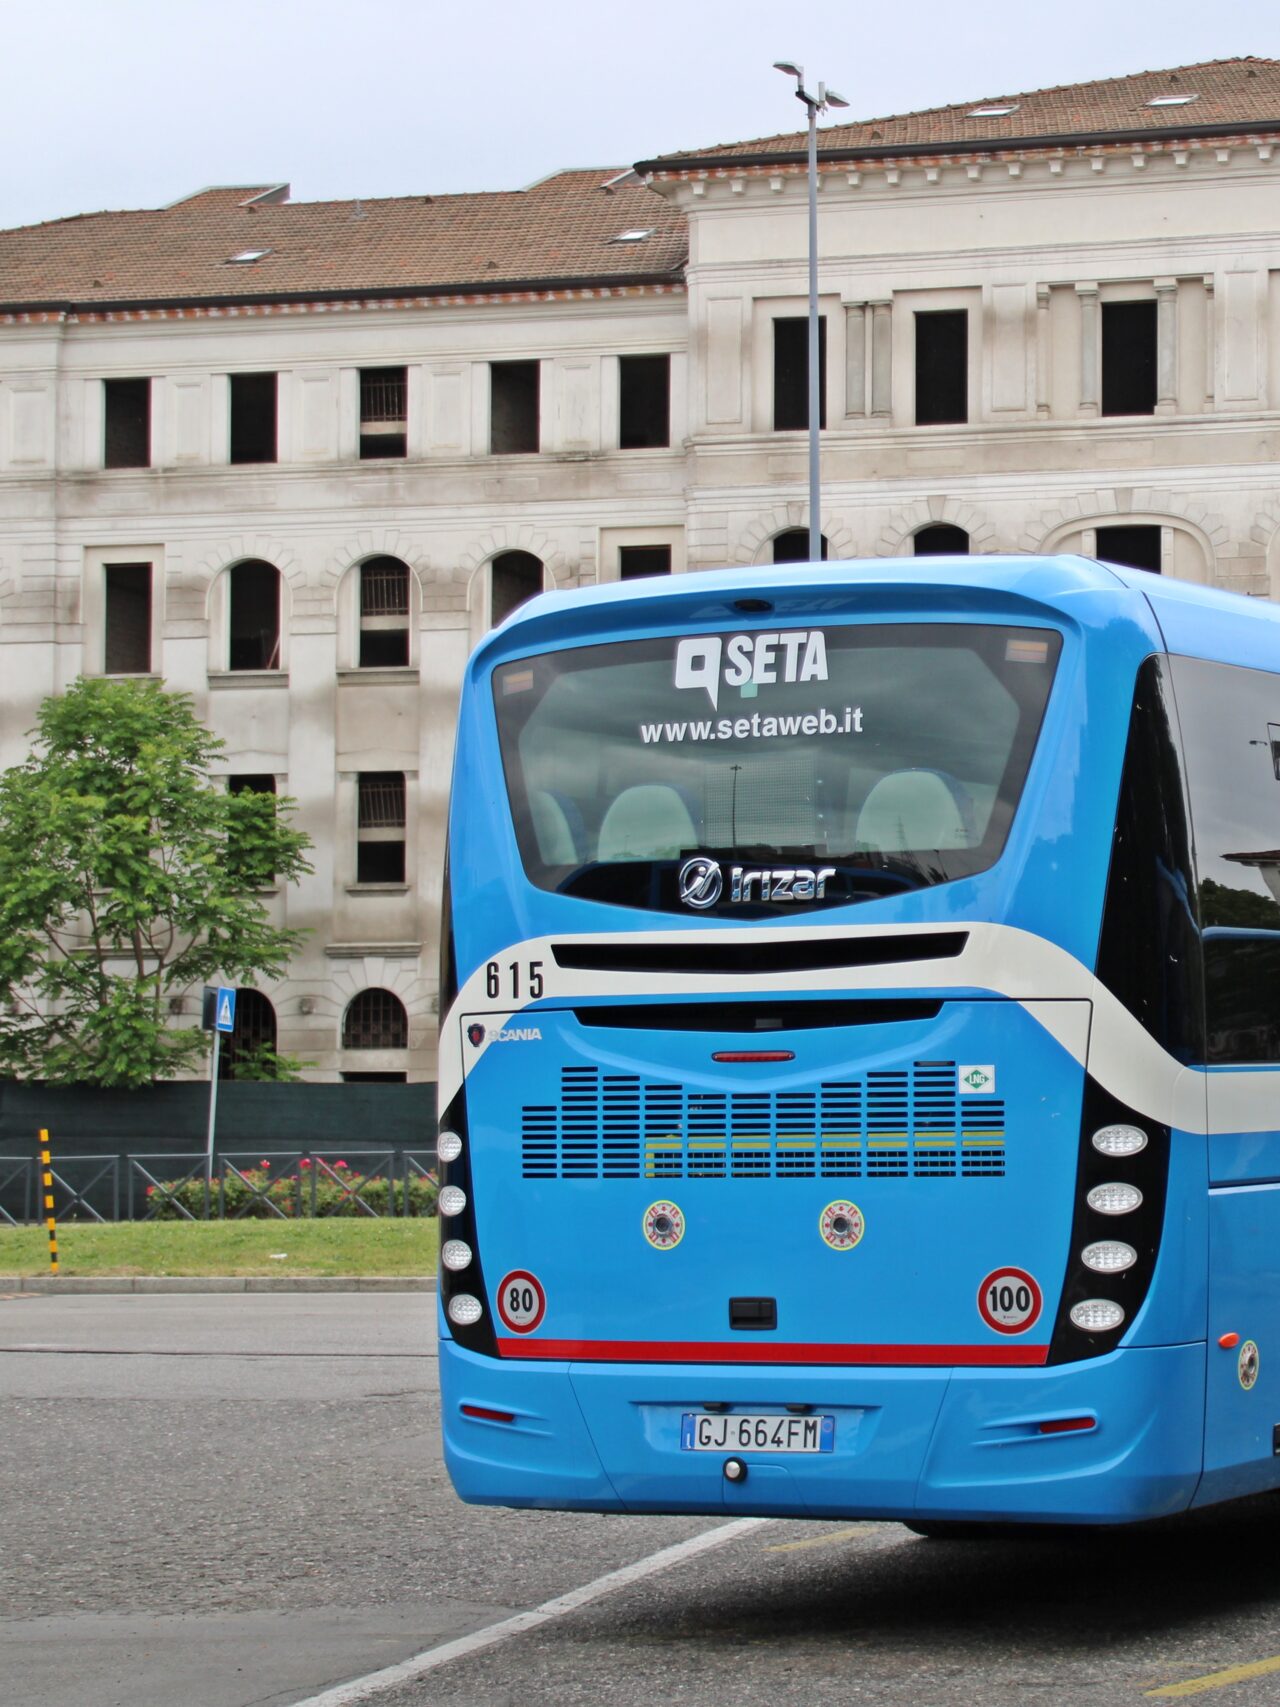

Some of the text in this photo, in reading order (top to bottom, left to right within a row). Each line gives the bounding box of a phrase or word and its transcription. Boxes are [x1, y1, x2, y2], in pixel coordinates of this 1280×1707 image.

[725, 631, 828, 686] SETA
[640, 707, 864, 743] www.setaweb.it
[486, 961, 544, 999] 615
[489, 1028, 542, 1042] SCANIA
[970, 1074, 986, 1084] LNG
[510, 1287, 533, 1312] 80
[990, 1285, 1031, 1312] 100
